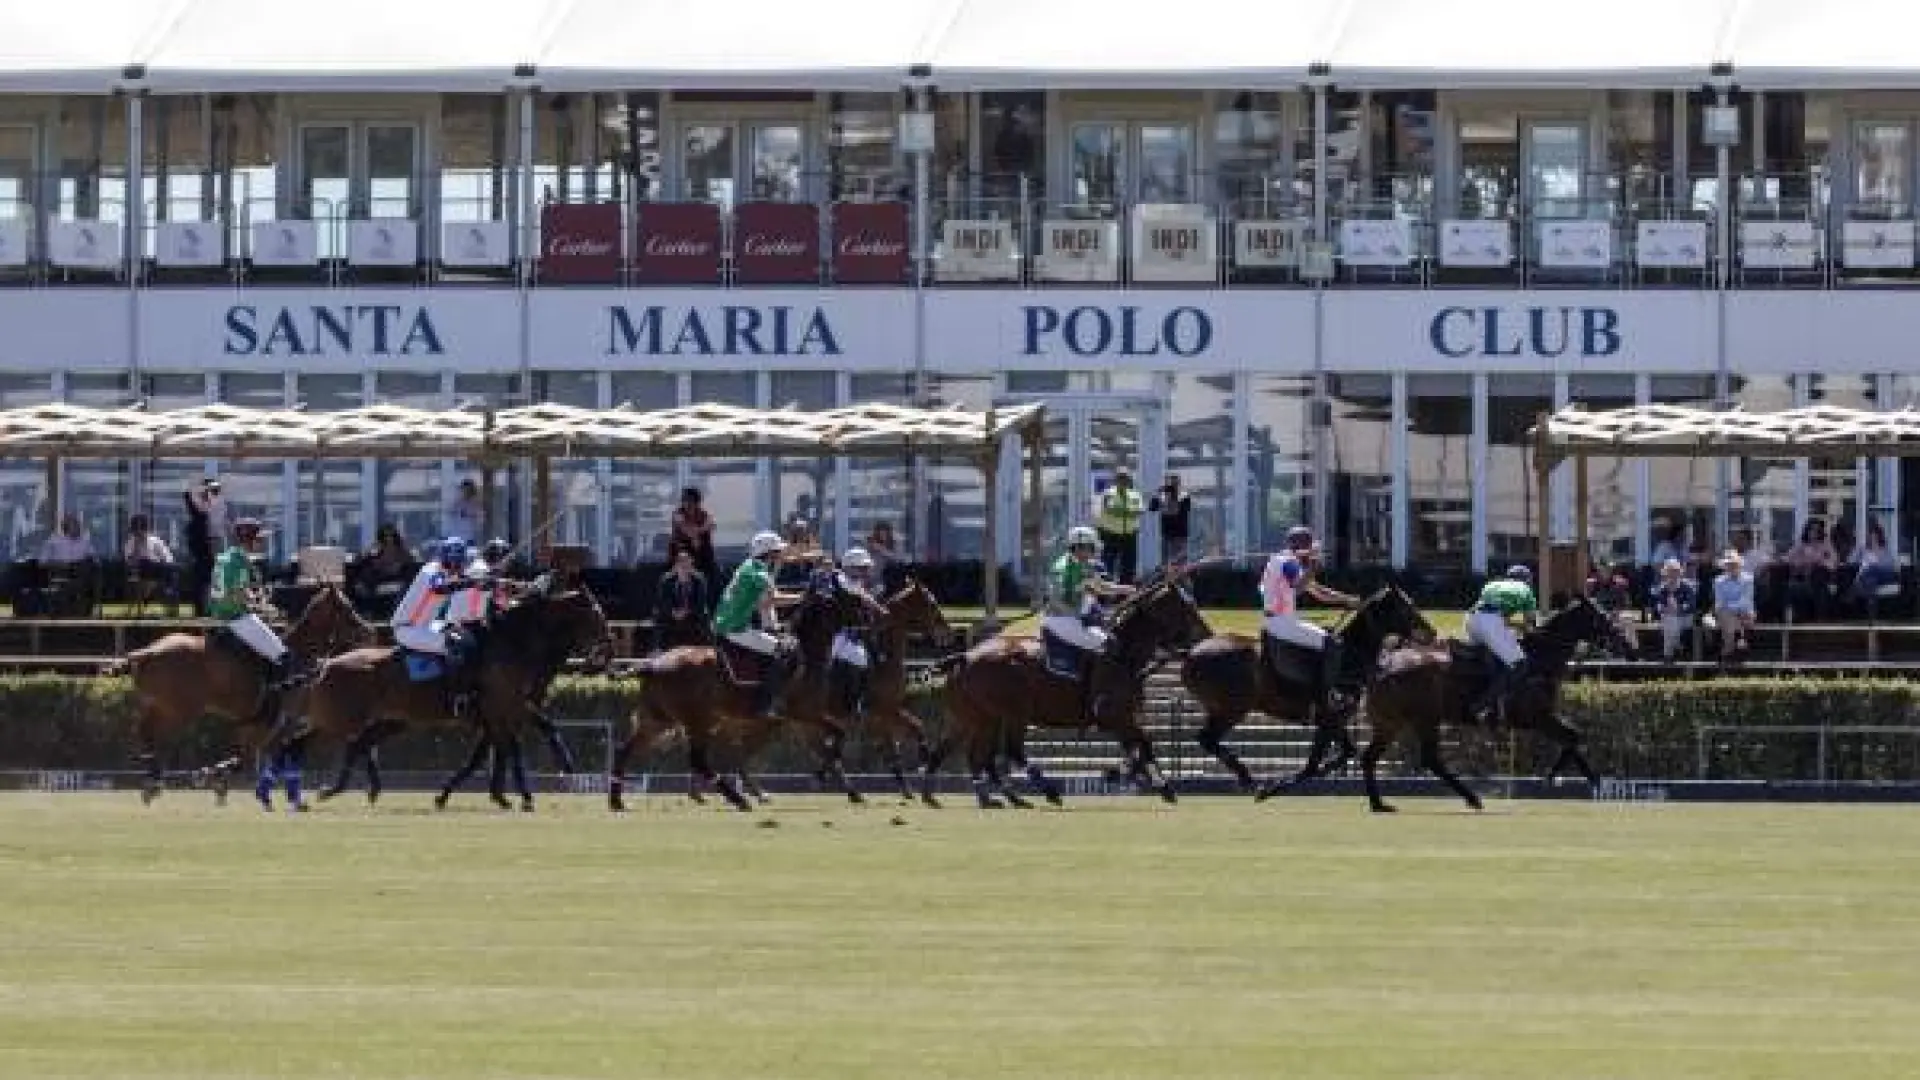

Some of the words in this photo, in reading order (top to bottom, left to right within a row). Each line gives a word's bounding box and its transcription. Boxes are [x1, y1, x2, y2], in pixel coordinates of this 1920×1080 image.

[224, 305, 444, 355] SANTA
[605, 305, 845, 355] MARIA
[1021, 305, 1213, 356] POLO
[1429, 306, 1622, 358] CLUB
